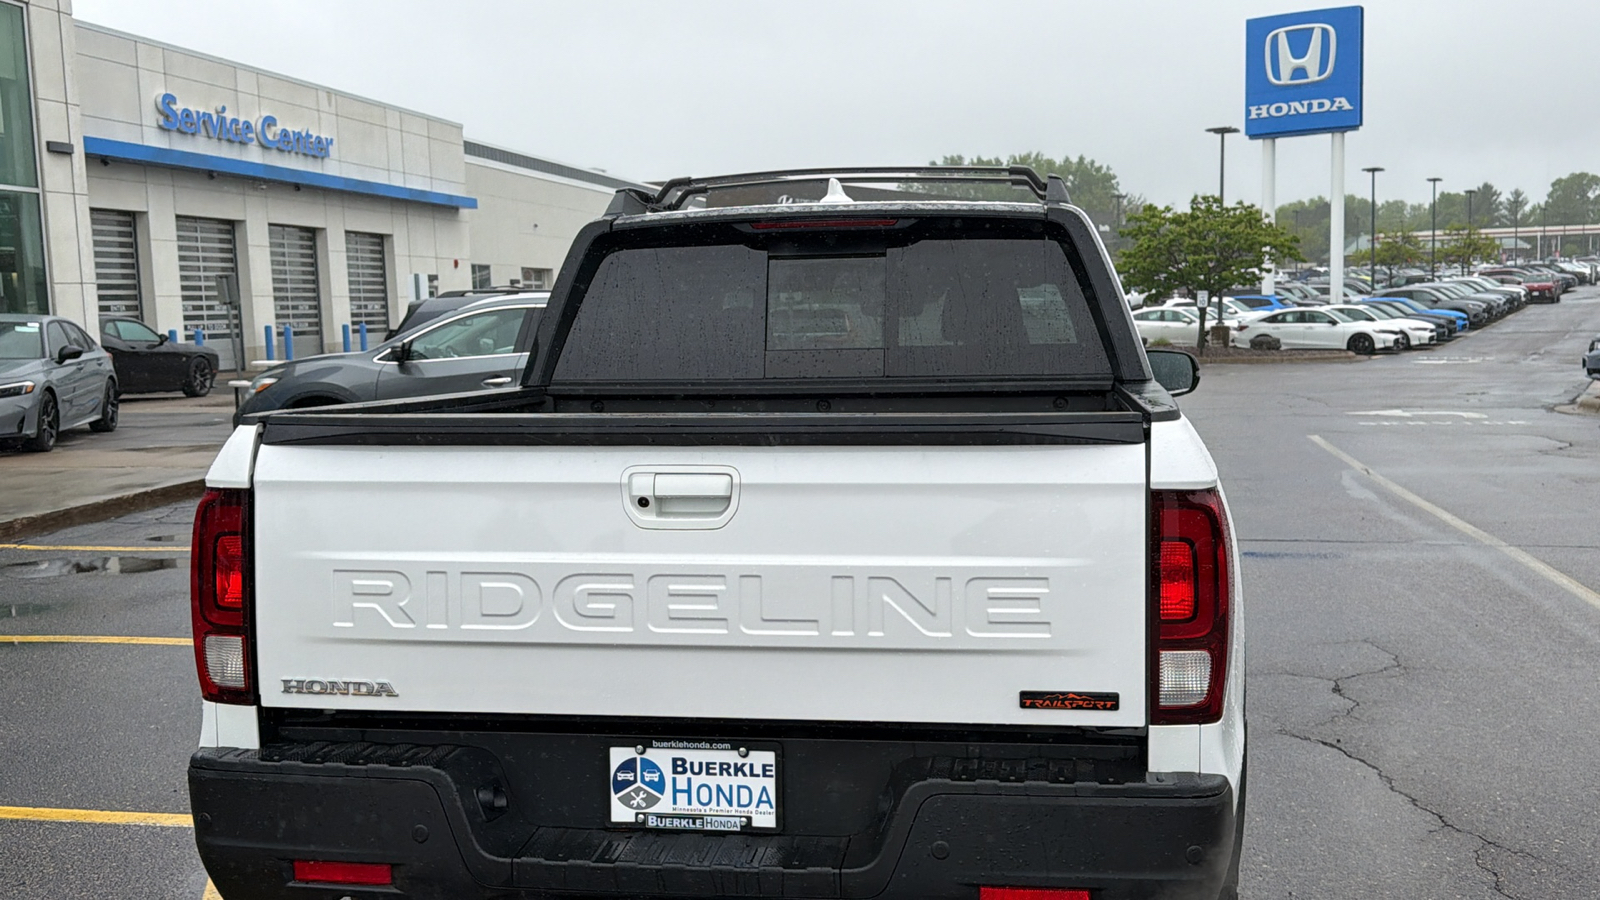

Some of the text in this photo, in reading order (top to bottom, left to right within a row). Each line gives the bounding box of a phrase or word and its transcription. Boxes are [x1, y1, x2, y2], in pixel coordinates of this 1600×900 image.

[1248, 96, 1354, 119] HONDA
[157, 92, 334, 158] Service Center
[332, 569, 1052, 639] RIDGELINE
[280, 678, 399, 697] HONDA
[1022, 699, 1116, 709] TRAILSPORT
[652, 740, 731, 749] buerklehonda.com
[671, 757, 774, 778] BUERKLE
[671, 777, 774, 809] HONDA
